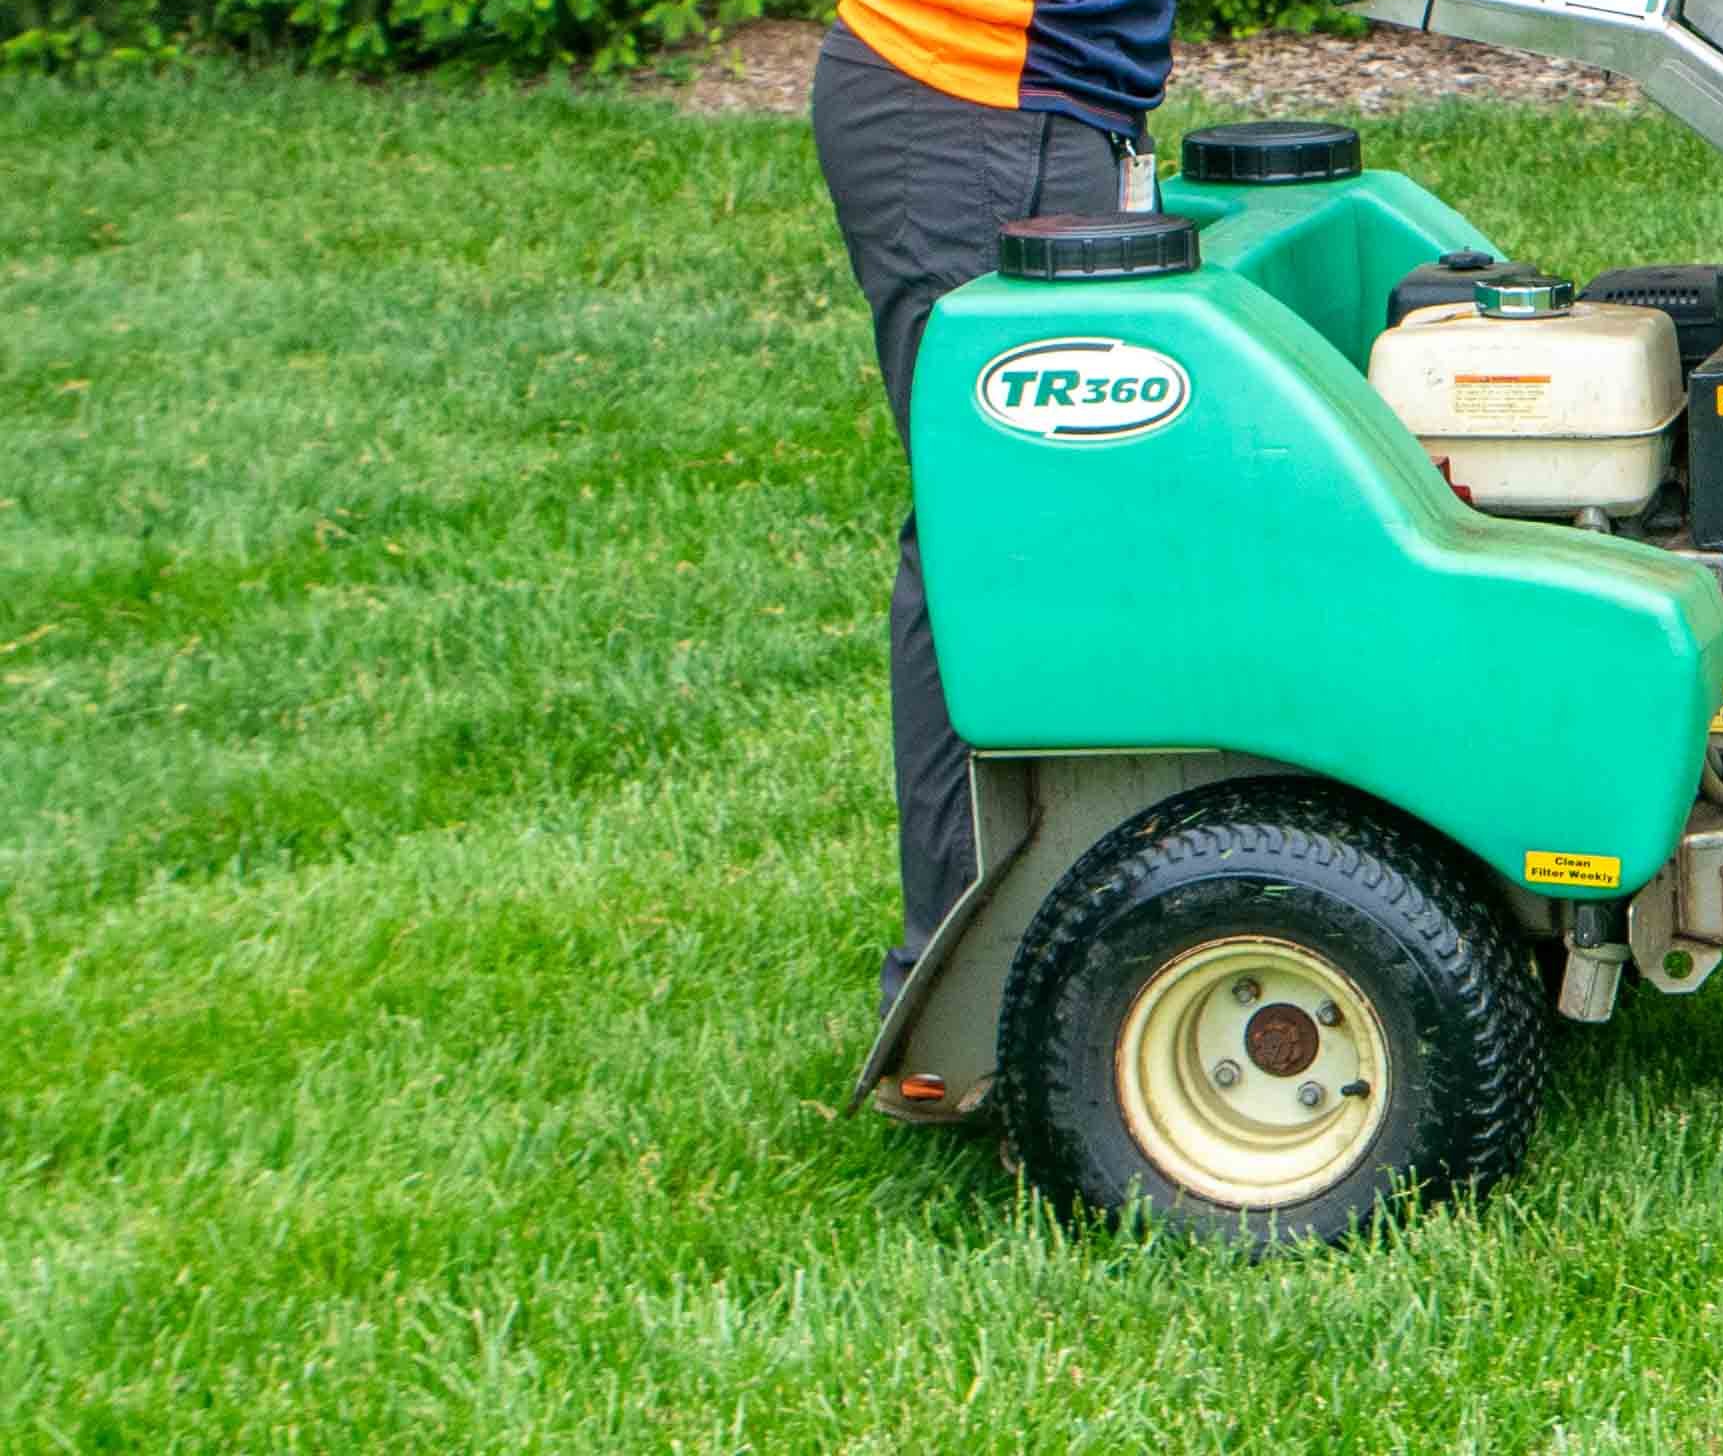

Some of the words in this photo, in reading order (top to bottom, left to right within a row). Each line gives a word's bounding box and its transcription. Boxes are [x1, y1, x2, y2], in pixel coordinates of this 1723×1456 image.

[1001, 370, 1170, 408] TR360
[1554, 856, 1592, 868] Clean
[1531, 867, 1566, 879] Filter
[1568, 870, 1613, 884] Weekly
